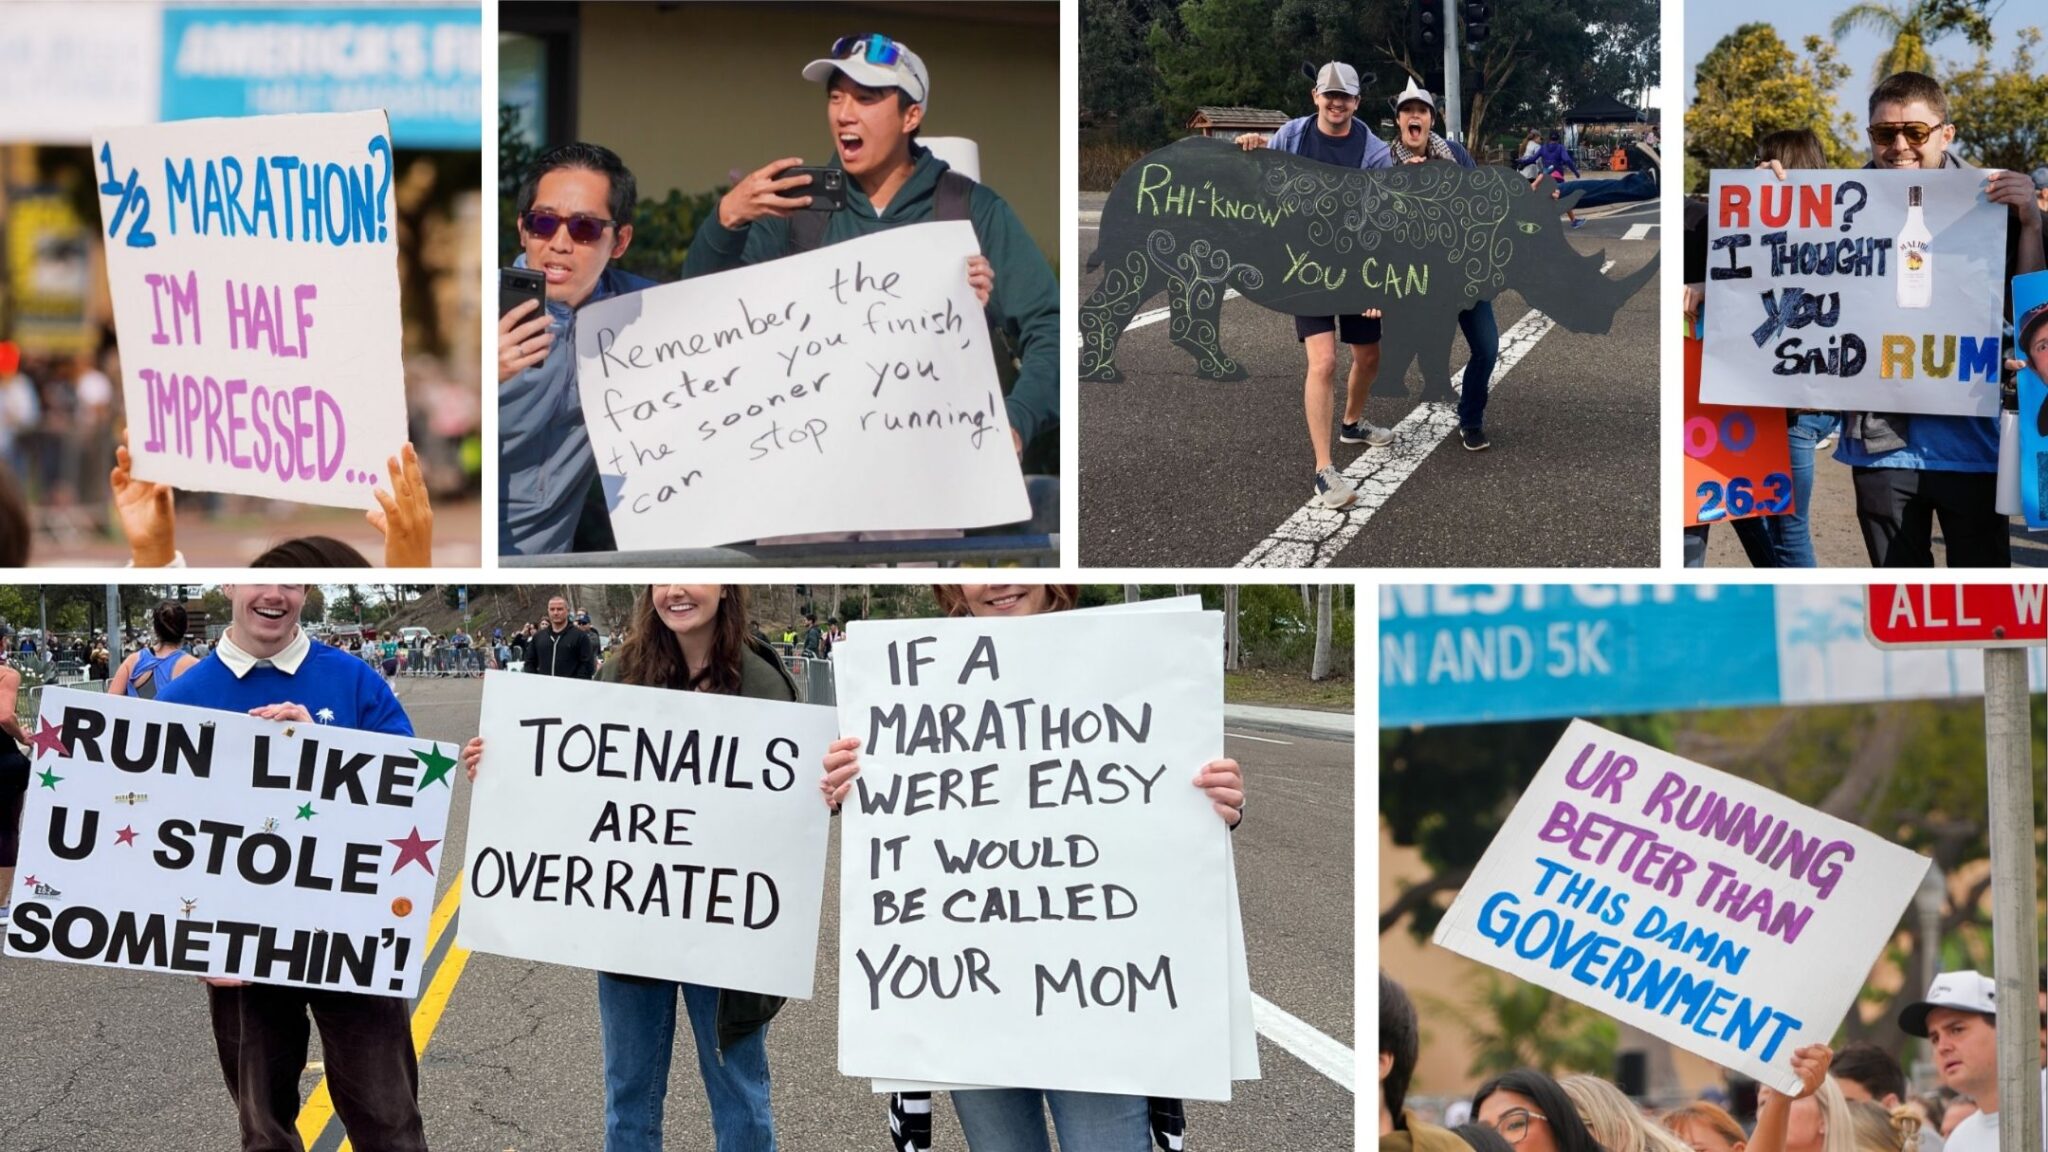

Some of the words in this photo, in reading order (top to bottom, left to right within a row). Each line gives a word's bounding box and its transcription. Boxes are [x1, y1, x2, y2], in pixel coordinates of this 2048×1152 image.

[165, 134, 393, 246] MARATHON?
[1718, 180, 1868, 232] RUN?
[1281, 243, 1346, 290] YOU
[1362, 256, 1429, 299] CAN
[1710, 233, 1753, 281] I
[1760, 231, 1893, 278] THOUGHT
[145, 270, 201, 346] I'M
[226, 279, 317, 359] HALF
[597, 298, 811, 377] Remember,
[829, 261, 902, 304] the
[603, 366, 741, 433] faster
[778, 334, 848, 377] you
[862, 301, 971, 349] finish,
[1880, 333, 1999, 383] RUM
[139, 368, 378, 485] IMPRESSED...
[609, 440, 676, 477] the
[698, 372, 830, 441] sooner
[870, 360, 940, 398] you
[632, 469, 703, 514] can
[749, 418, 829, 462] stop
[860, 391, 1001, 450] running!
[1696, 472, 1793, 520] 26.3
[1887, 584, 1982, 629] ALL
[886, 636, 937, 687] IF
[957, 635, 1000, 685] A
[1427, 622, 1535, 684] AND
[1546, 618, 1611, 678] 5K
[59, 706, 216, 779] RUN
[251, 734, 420, 808] LIKE
[519, 717, 800, 792] TOENAILS
[865, 697, 1153, 756] MARATHON
[588, 800, 697, 846] ARE
[856, 762, 1000, 816] WERE
[1028, 758, 1168, 809] EASY
[1564, 742, 1639, 805] UR
[1641, 770, 1856, 900] RUNNING
[48, 806, 99, 860] U
[153, 818, 384, 895] STOLE
[471, 846, 781, 930] OVERRATED
[870, 834, 910, 880] IT
[934, 833, 1099, 875] WOULD
[1538, 800, 1697, 899] BETTER
[1695, 861, 1814, 945] THAN
[872, 887, 927, 927] BE
[942, 883, 1138, 924] CALLED
[1533, 857, 1632, 925] THIS
[1632, 904, 1751, 977] DAMN
[7, 901, 411, 991] SOMETHIN'!
[855, 943, 1001, 1011] YOUR
[1035, 954, 1178, 1017] MOM
[1476, 890, 1804, 1064] GOVERNMENT
